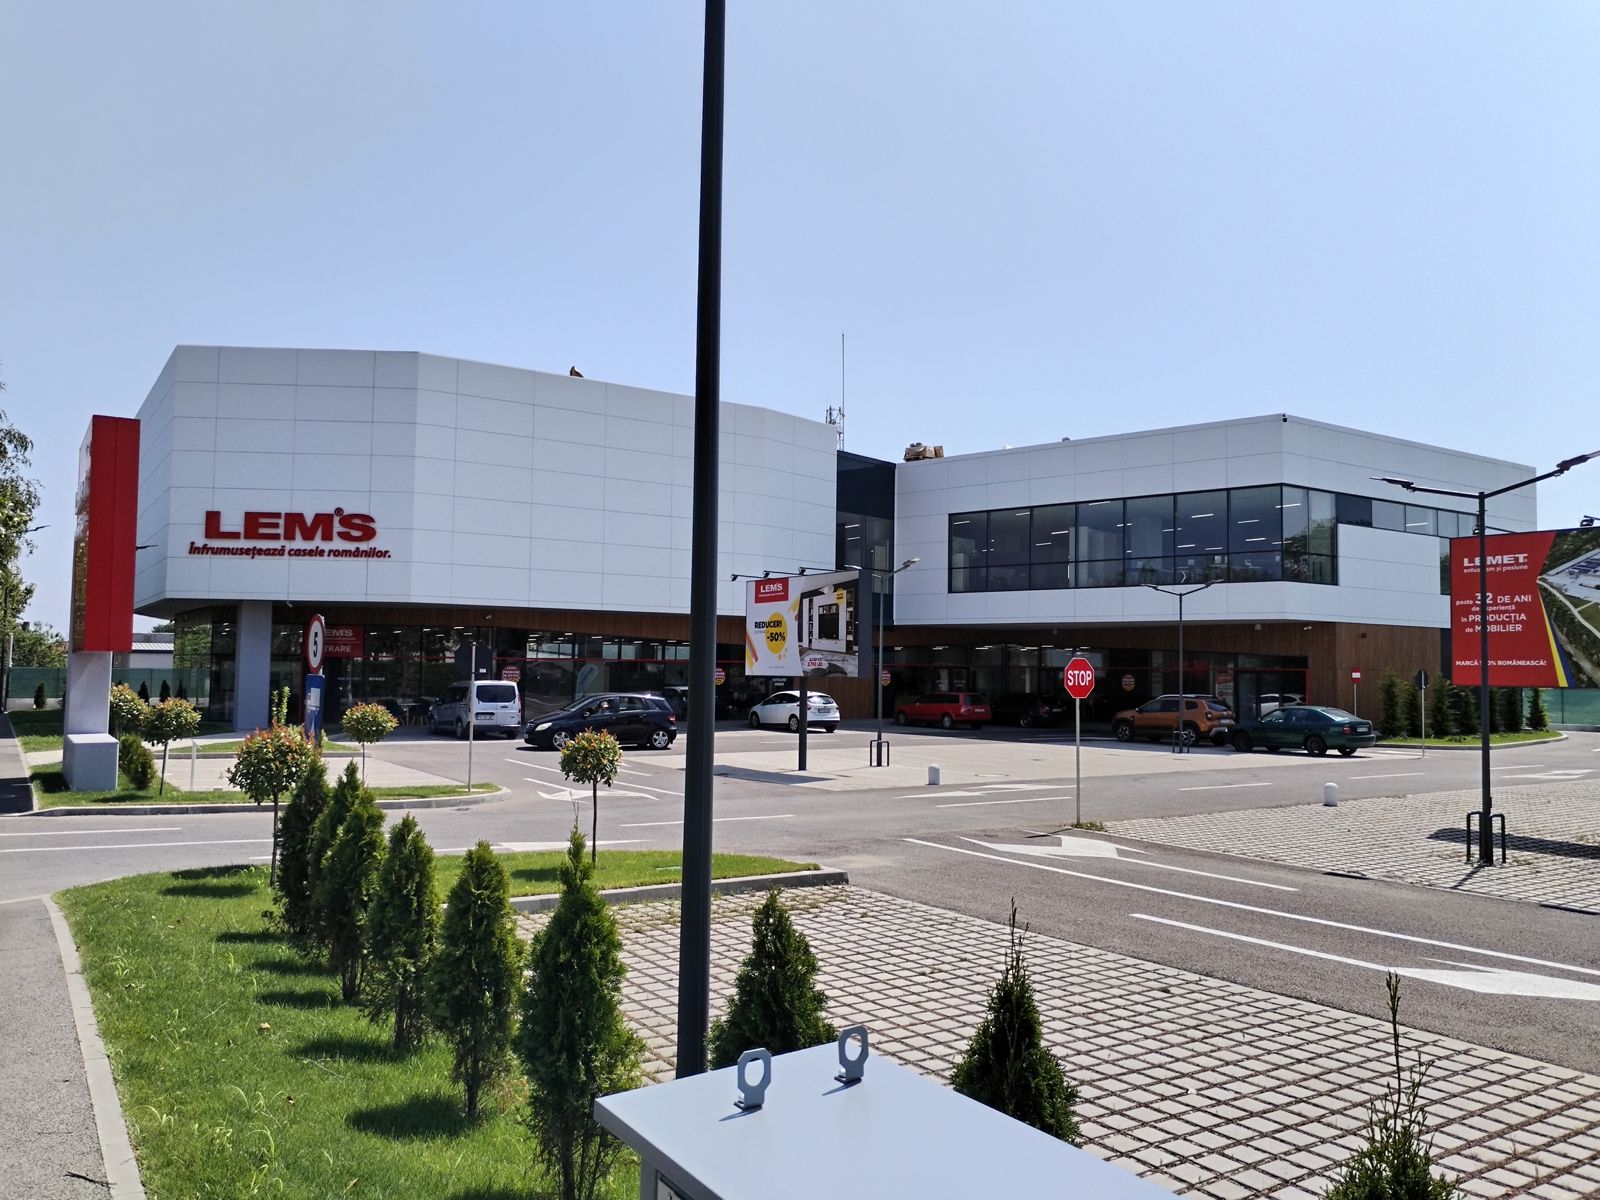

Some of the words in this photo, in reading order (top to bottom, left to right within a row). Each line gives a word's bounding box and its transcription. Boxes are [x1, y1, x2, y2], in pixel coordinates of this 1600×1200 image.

[288, 546, 325, 557] casele
[327, 546, 391, 558] românilor.
[1475, 593, 1493, 604] 32
[1497, 595, 1511, 603] DE
[1514, 594, 1532, 603] ANI
[1468, 612, 1527, 623] PRDUCȚIA
[767, 632, 786, 642] -50%
[313, 631, 319, 658] 5
[1067, 670, 1092, 686] STOP
